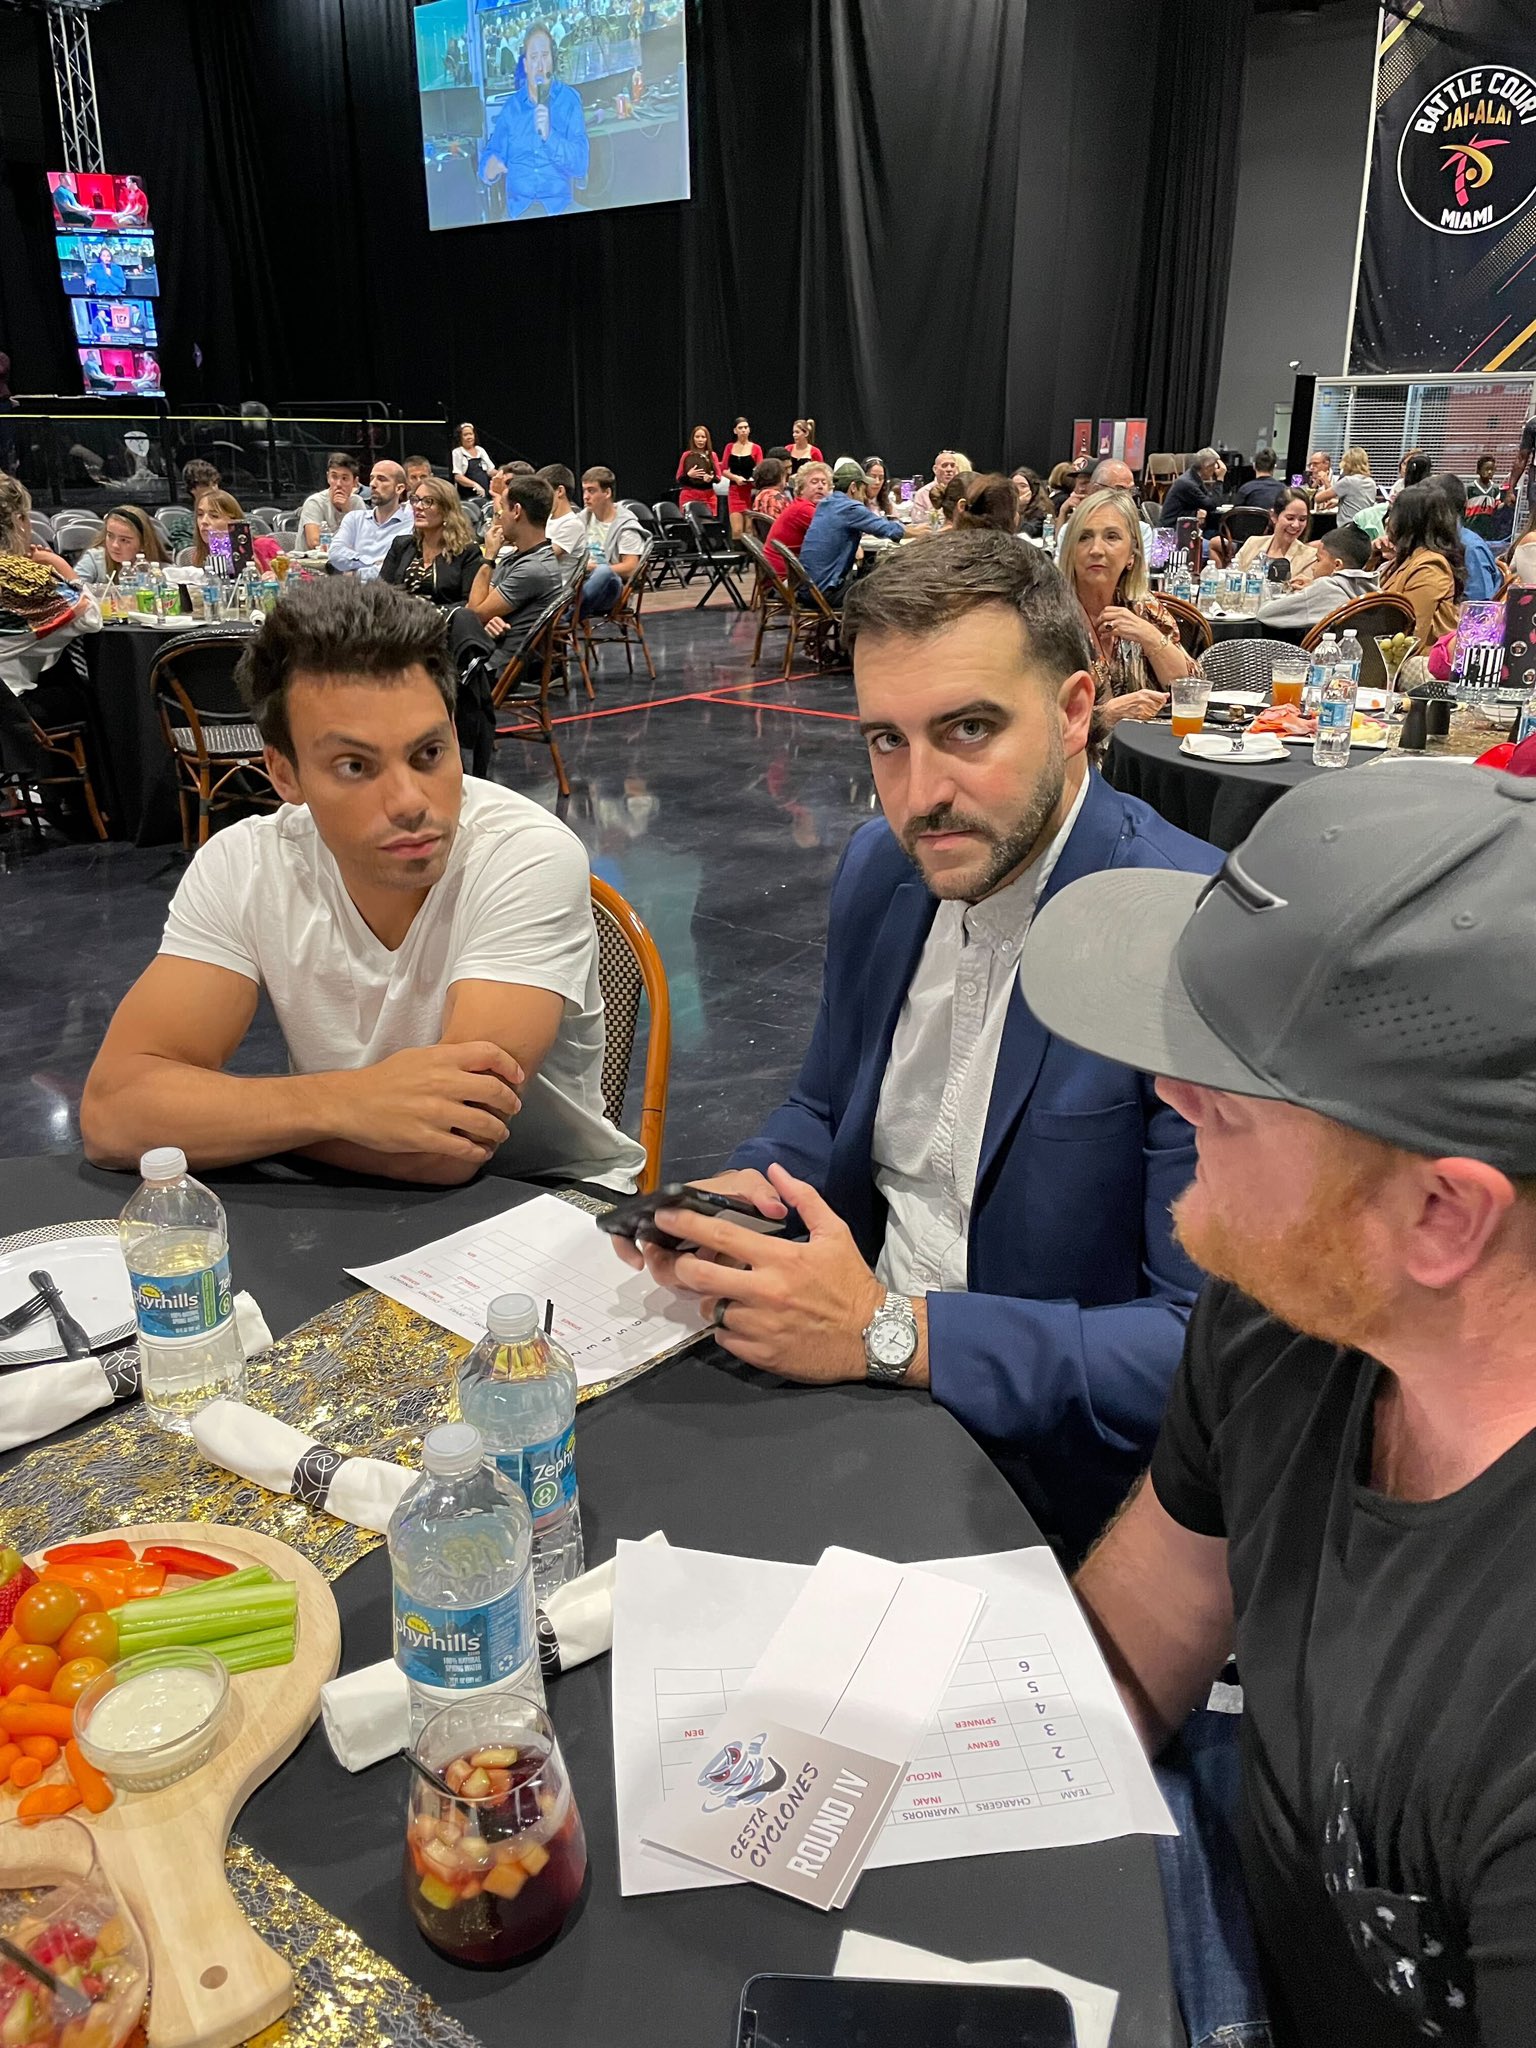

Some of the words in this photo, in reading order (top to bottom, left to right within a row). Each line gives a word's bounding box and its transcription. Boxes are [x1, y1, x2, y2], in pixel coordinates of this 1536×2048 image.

[1414, 72, 1483, 134] BATTLE
[1443, 99, 1512, 132] JAI-ALAI
[1440, 204, 1493, 229] MIAMI
[1018, 1661, 1030, 1673] 6
[1027, 1681, 1039, 1693] 5
[1035, 1702, 1046, 1714] 4
[954, 1716, 997, 1729] SPINNER
[684, 1728, 705, 1738] BEN
[1043, 1723, 1057, 1736] 3
[967, 1739, 1000, 1751] BENNY
[1051, 1746, 1066, 1759] 2
[1061, 1769, 1074, 1782] 1
[1060, 1787, 1092, 1800] TEAM
[913, 1796, 942, 1806] INAKI
[976, 1797, 1031, 1812] CHARGERS
[750, 1762, 820, 1868] CYCLONES
[902, 1807, 960, 1821] WARRIORS
[786, 1796, 856, 1880] ROUND
[832, 1767, 869, 1799] IV
[730, 1807, 768, 1859] CESTA
